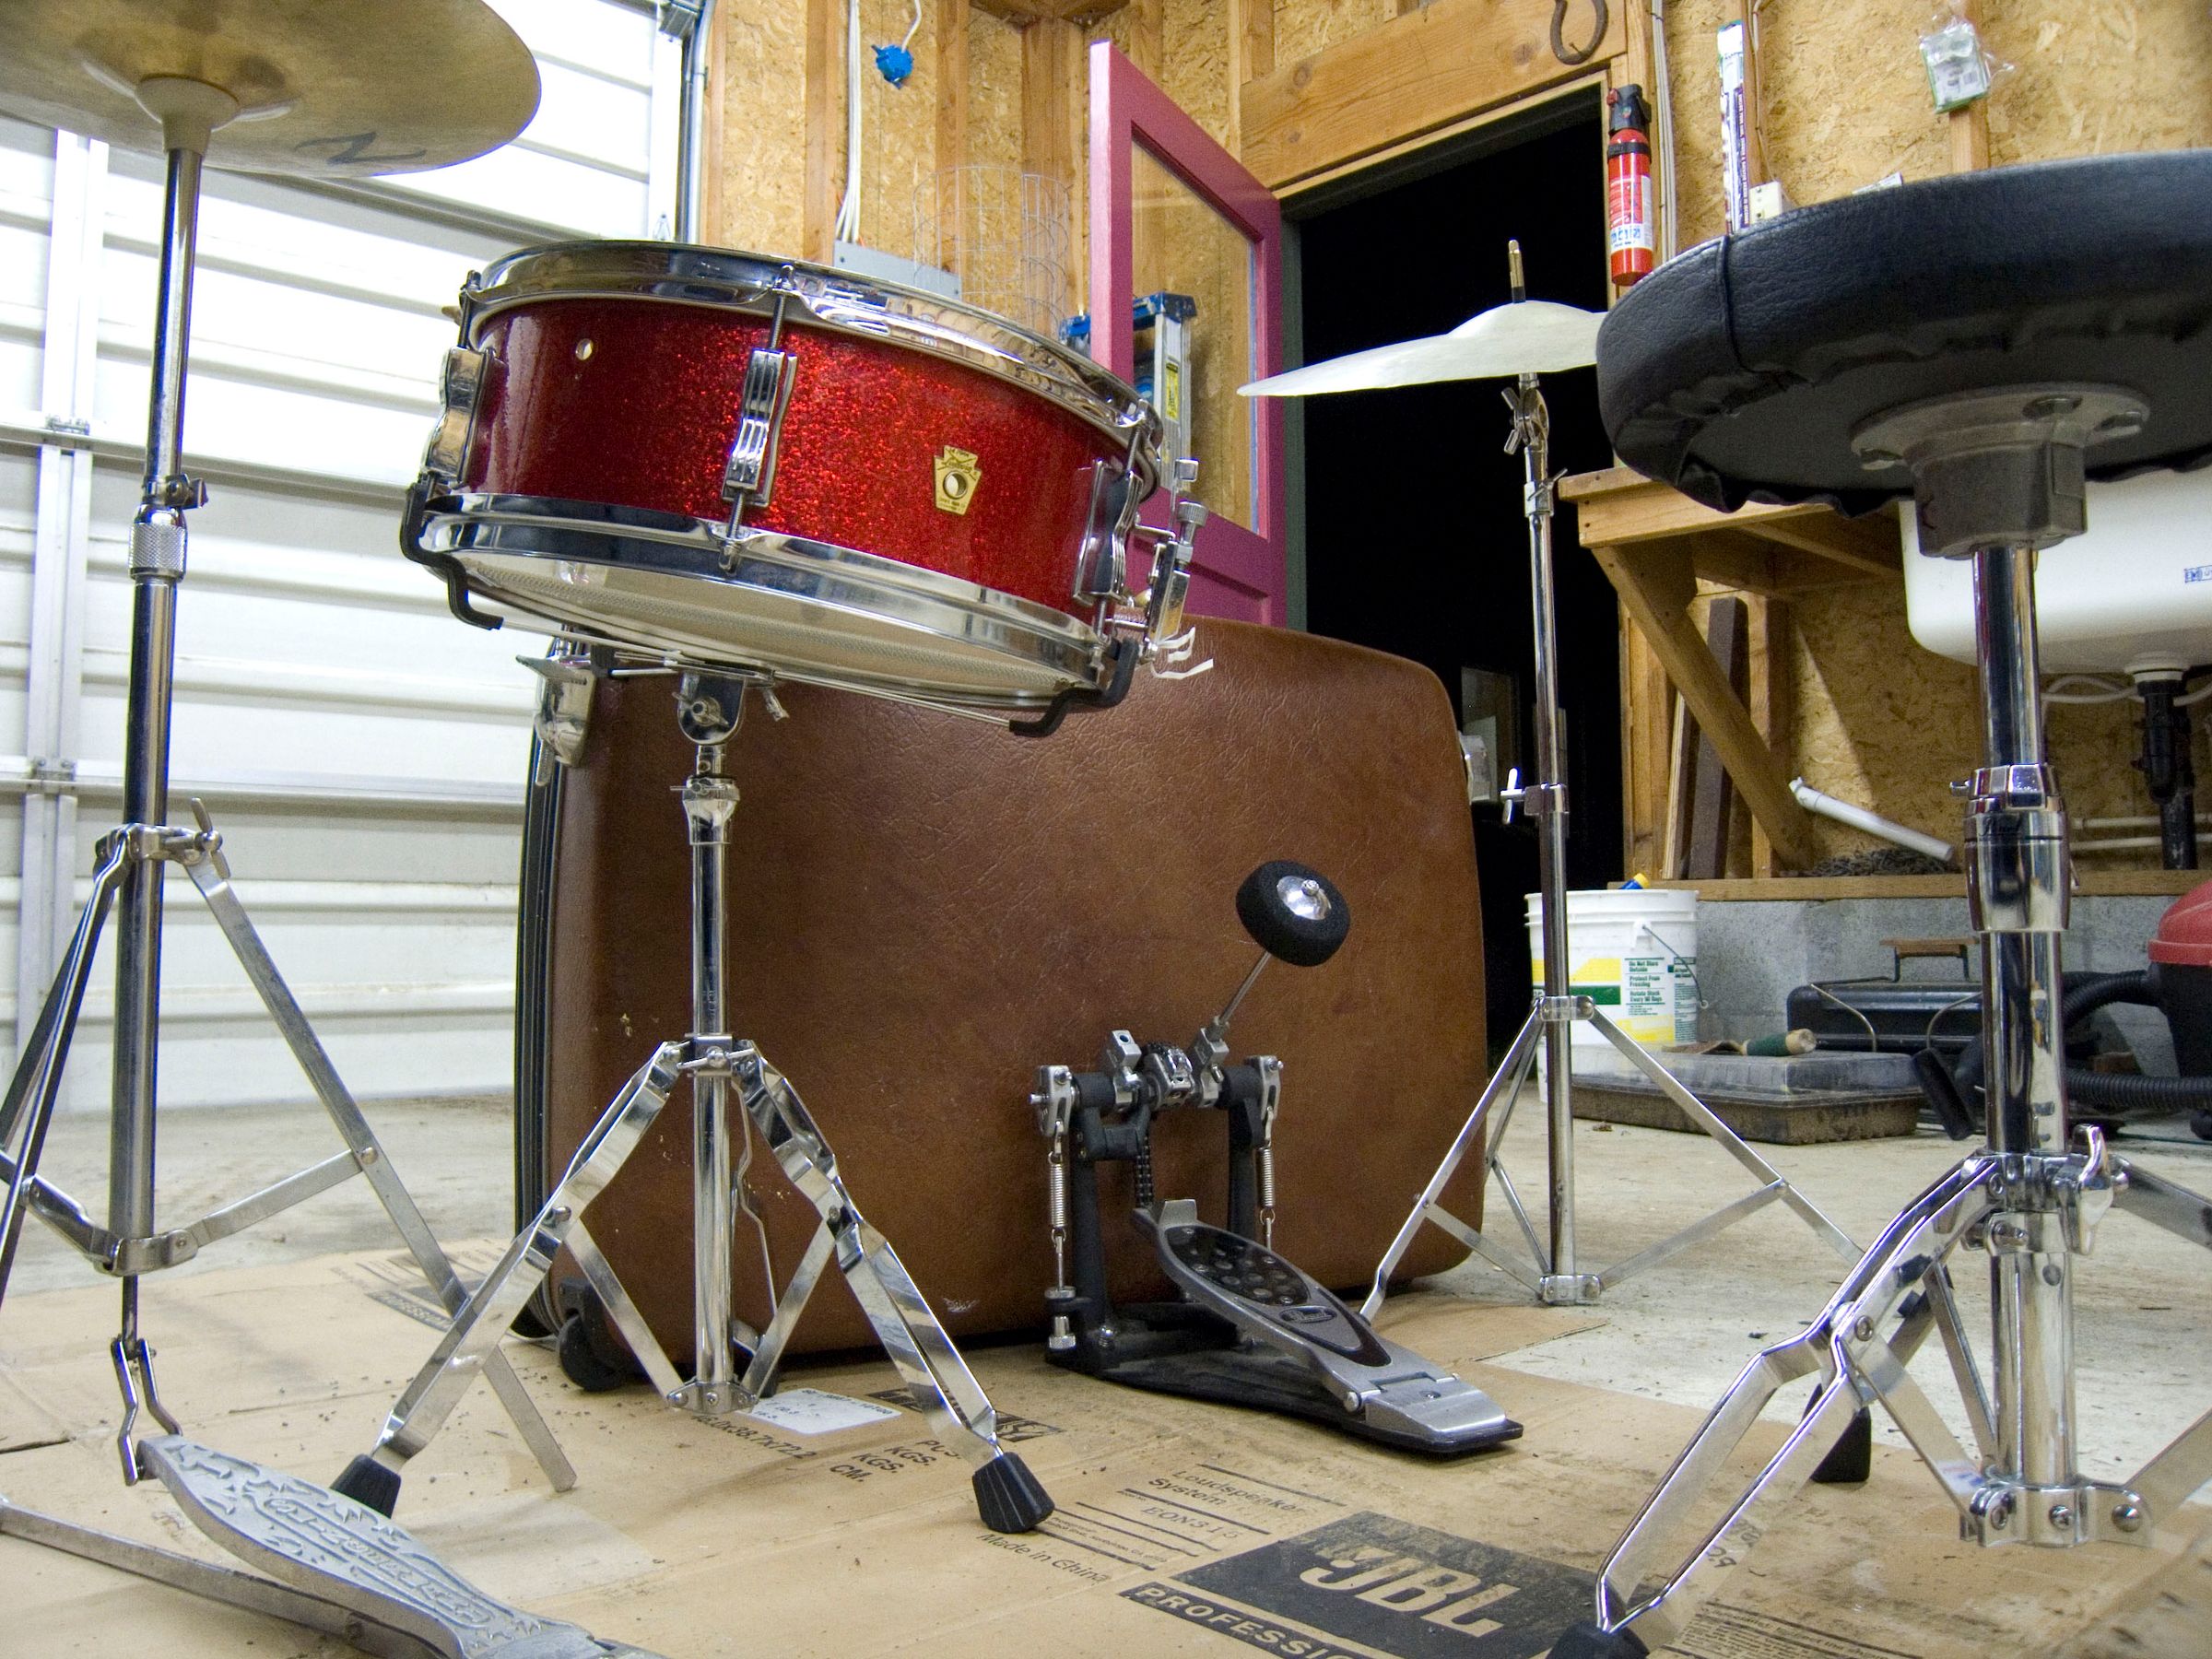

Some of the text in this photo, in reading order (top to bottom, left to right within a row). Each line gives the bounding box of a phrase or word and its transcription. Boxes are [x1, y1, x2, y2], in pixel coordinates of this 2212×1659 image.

[830, 1464, 873, 1482] CM.
[852, 1453, 904, 1474] KGS.
[884, 1445, 936, 1466] KGS.
[1148, 1477, 1227, 1505] System
[1171, 1470, 1306, 1512] Loudspeaker
[976, 1534, 1112, 1583] Made in China
[1299, 1543, 1521, 1638] JBL
[1135, 1588, 1354, 1659] PROFESSI
